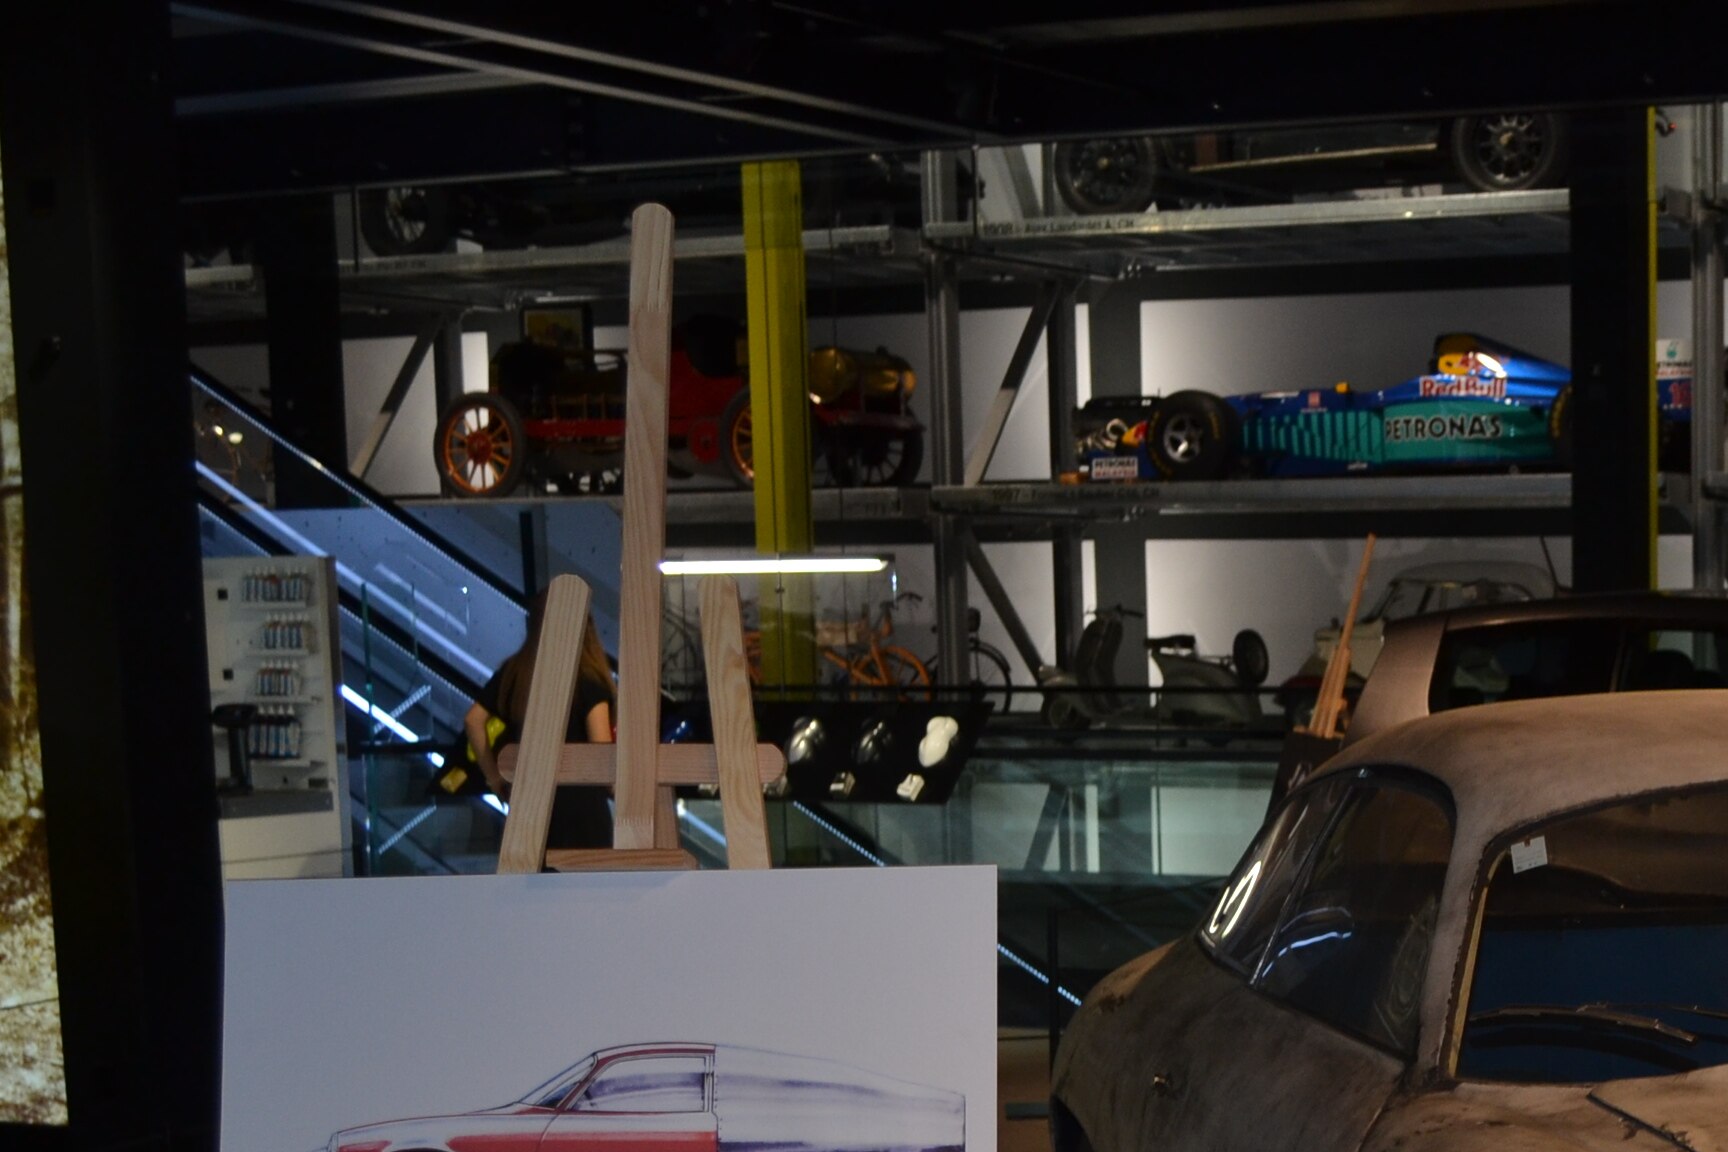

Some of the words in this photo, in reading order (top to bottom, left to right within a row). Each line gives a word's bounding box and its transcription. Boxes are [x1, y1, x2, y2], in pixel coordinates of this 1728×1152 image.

[1117, 218, 1134, 229] CH
[1421, 377, 1462, 397] Red
[1465, 377, 1506, 398] Bull
[1385, 414, 1502, 440] PETRONAS
[1143, 487, 1160, 498] CH
